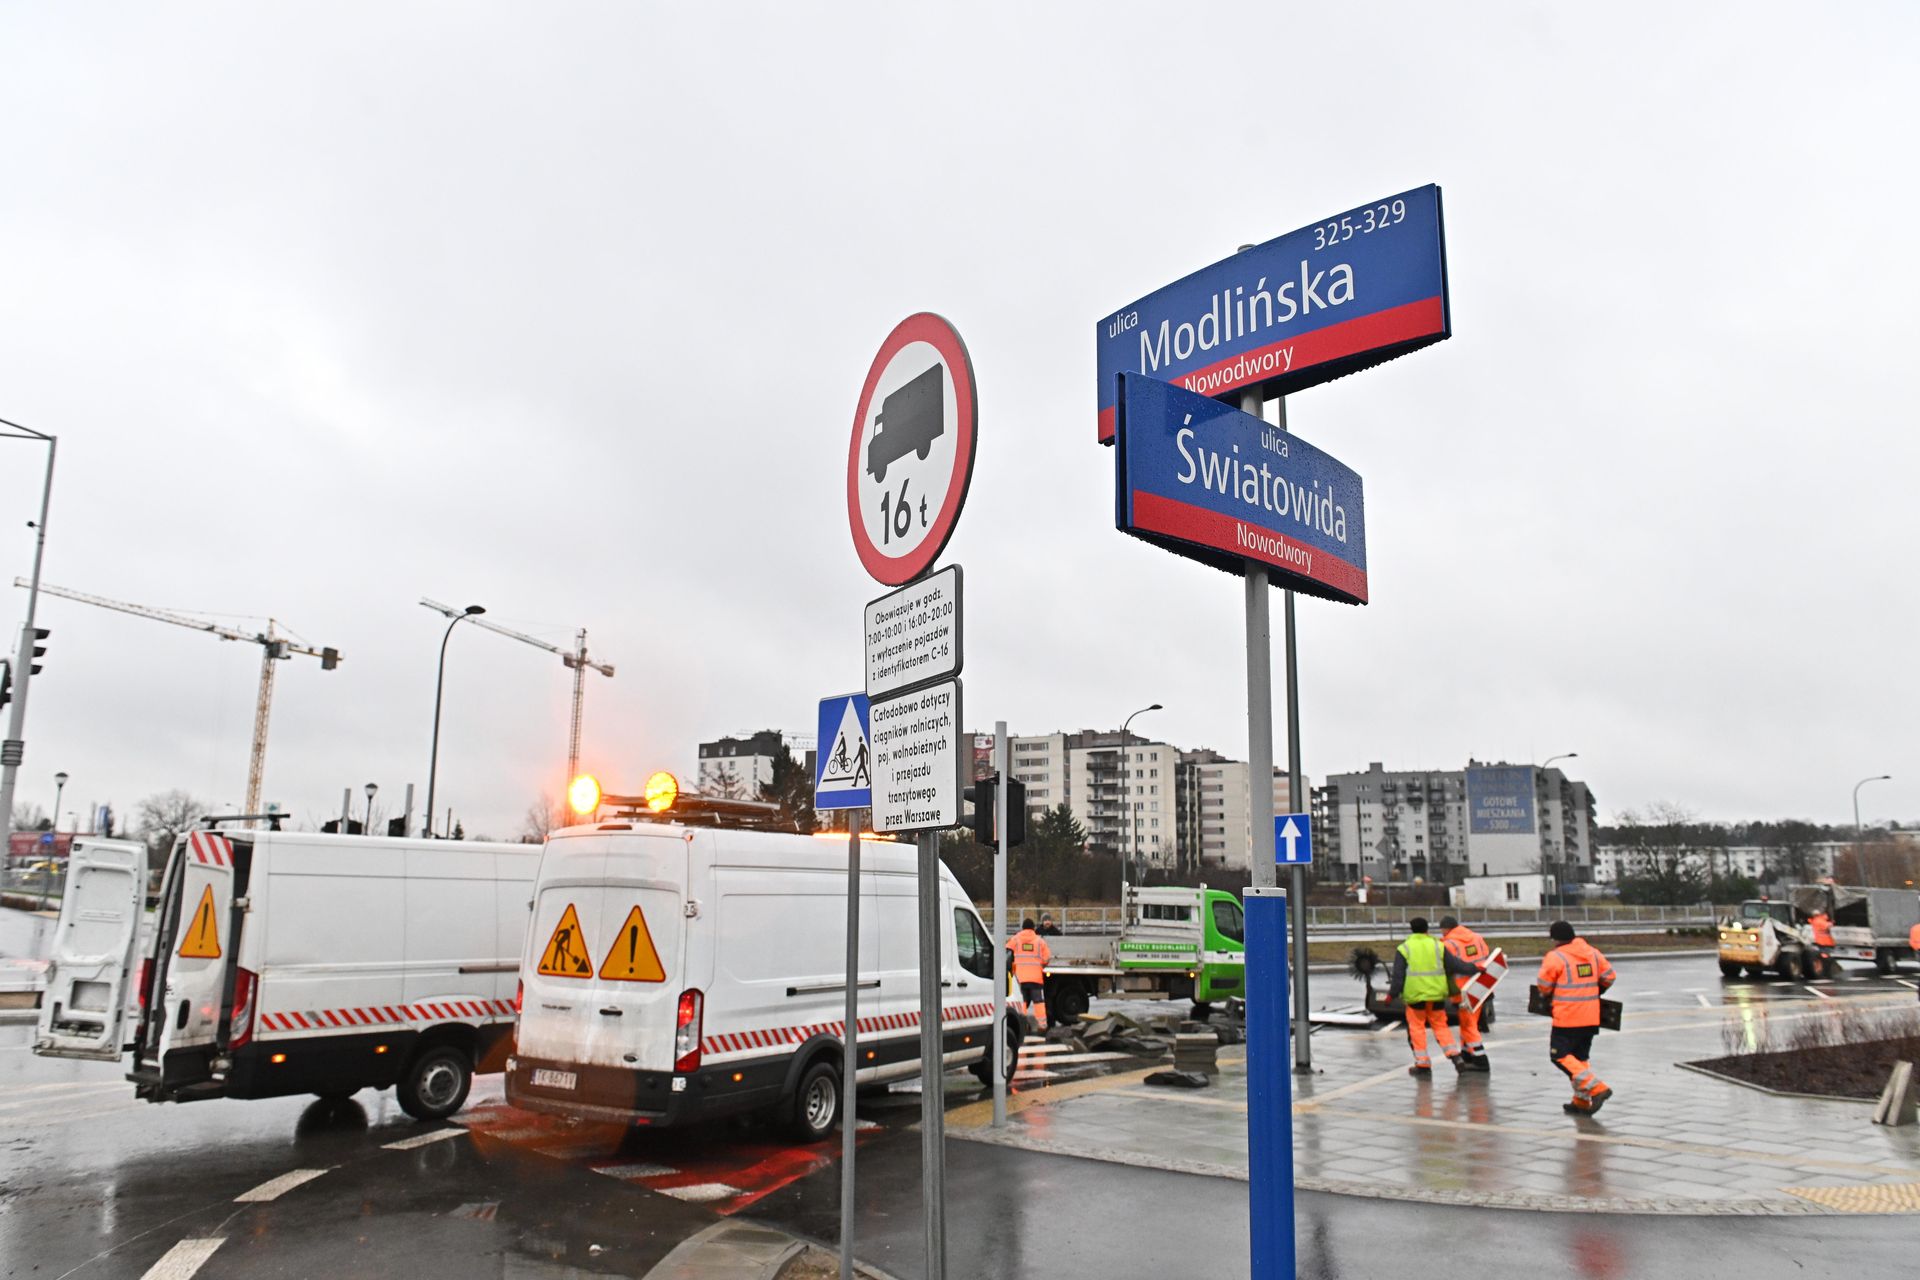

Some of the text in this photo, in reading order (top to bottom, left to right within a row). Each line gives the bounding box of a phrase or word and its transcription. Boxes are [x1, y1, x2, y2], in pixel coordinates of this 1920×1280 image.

[1314, 200, 1406, 250] 325-329
[1109, 310, 1138, 339] ulica
[1140, 260, 1355, 375] Modlińska
[1185, 346, 1294, 394] Nowodwory
[1261, 428, 1289, 458] ulica
[1176, 413, 1347, 543] Światowida
[881, 477, 927, 545] 16 t
[1237, 523, 1313, 574] Nowodwory
[868, 601, 953, 646] 7:00-10:00 i 16:00-20:00
[875, 587, 943, 625] Obowiązuje w godz.
[872, 625, 949, 663] z wyłączenie pojazdów
[872, 642, 949, 681] z identyfikatorem C-16
[874, 691, 950, 722] Całodobowo dotyczy
[873, 712, 951, 745] ciągników rolniczych,
[878, 735, 947, 767] poj. wolnobieżnych
[891, 762, 931, 785] i przejazdu
[888, 787, 936, 806] tranzytowego
[1477, 808, 1527, 818] MIESZKANIA
[1483, 796, 1518, 807] GOTOWE
[885, 809, 941, 830] przez Warszawę
